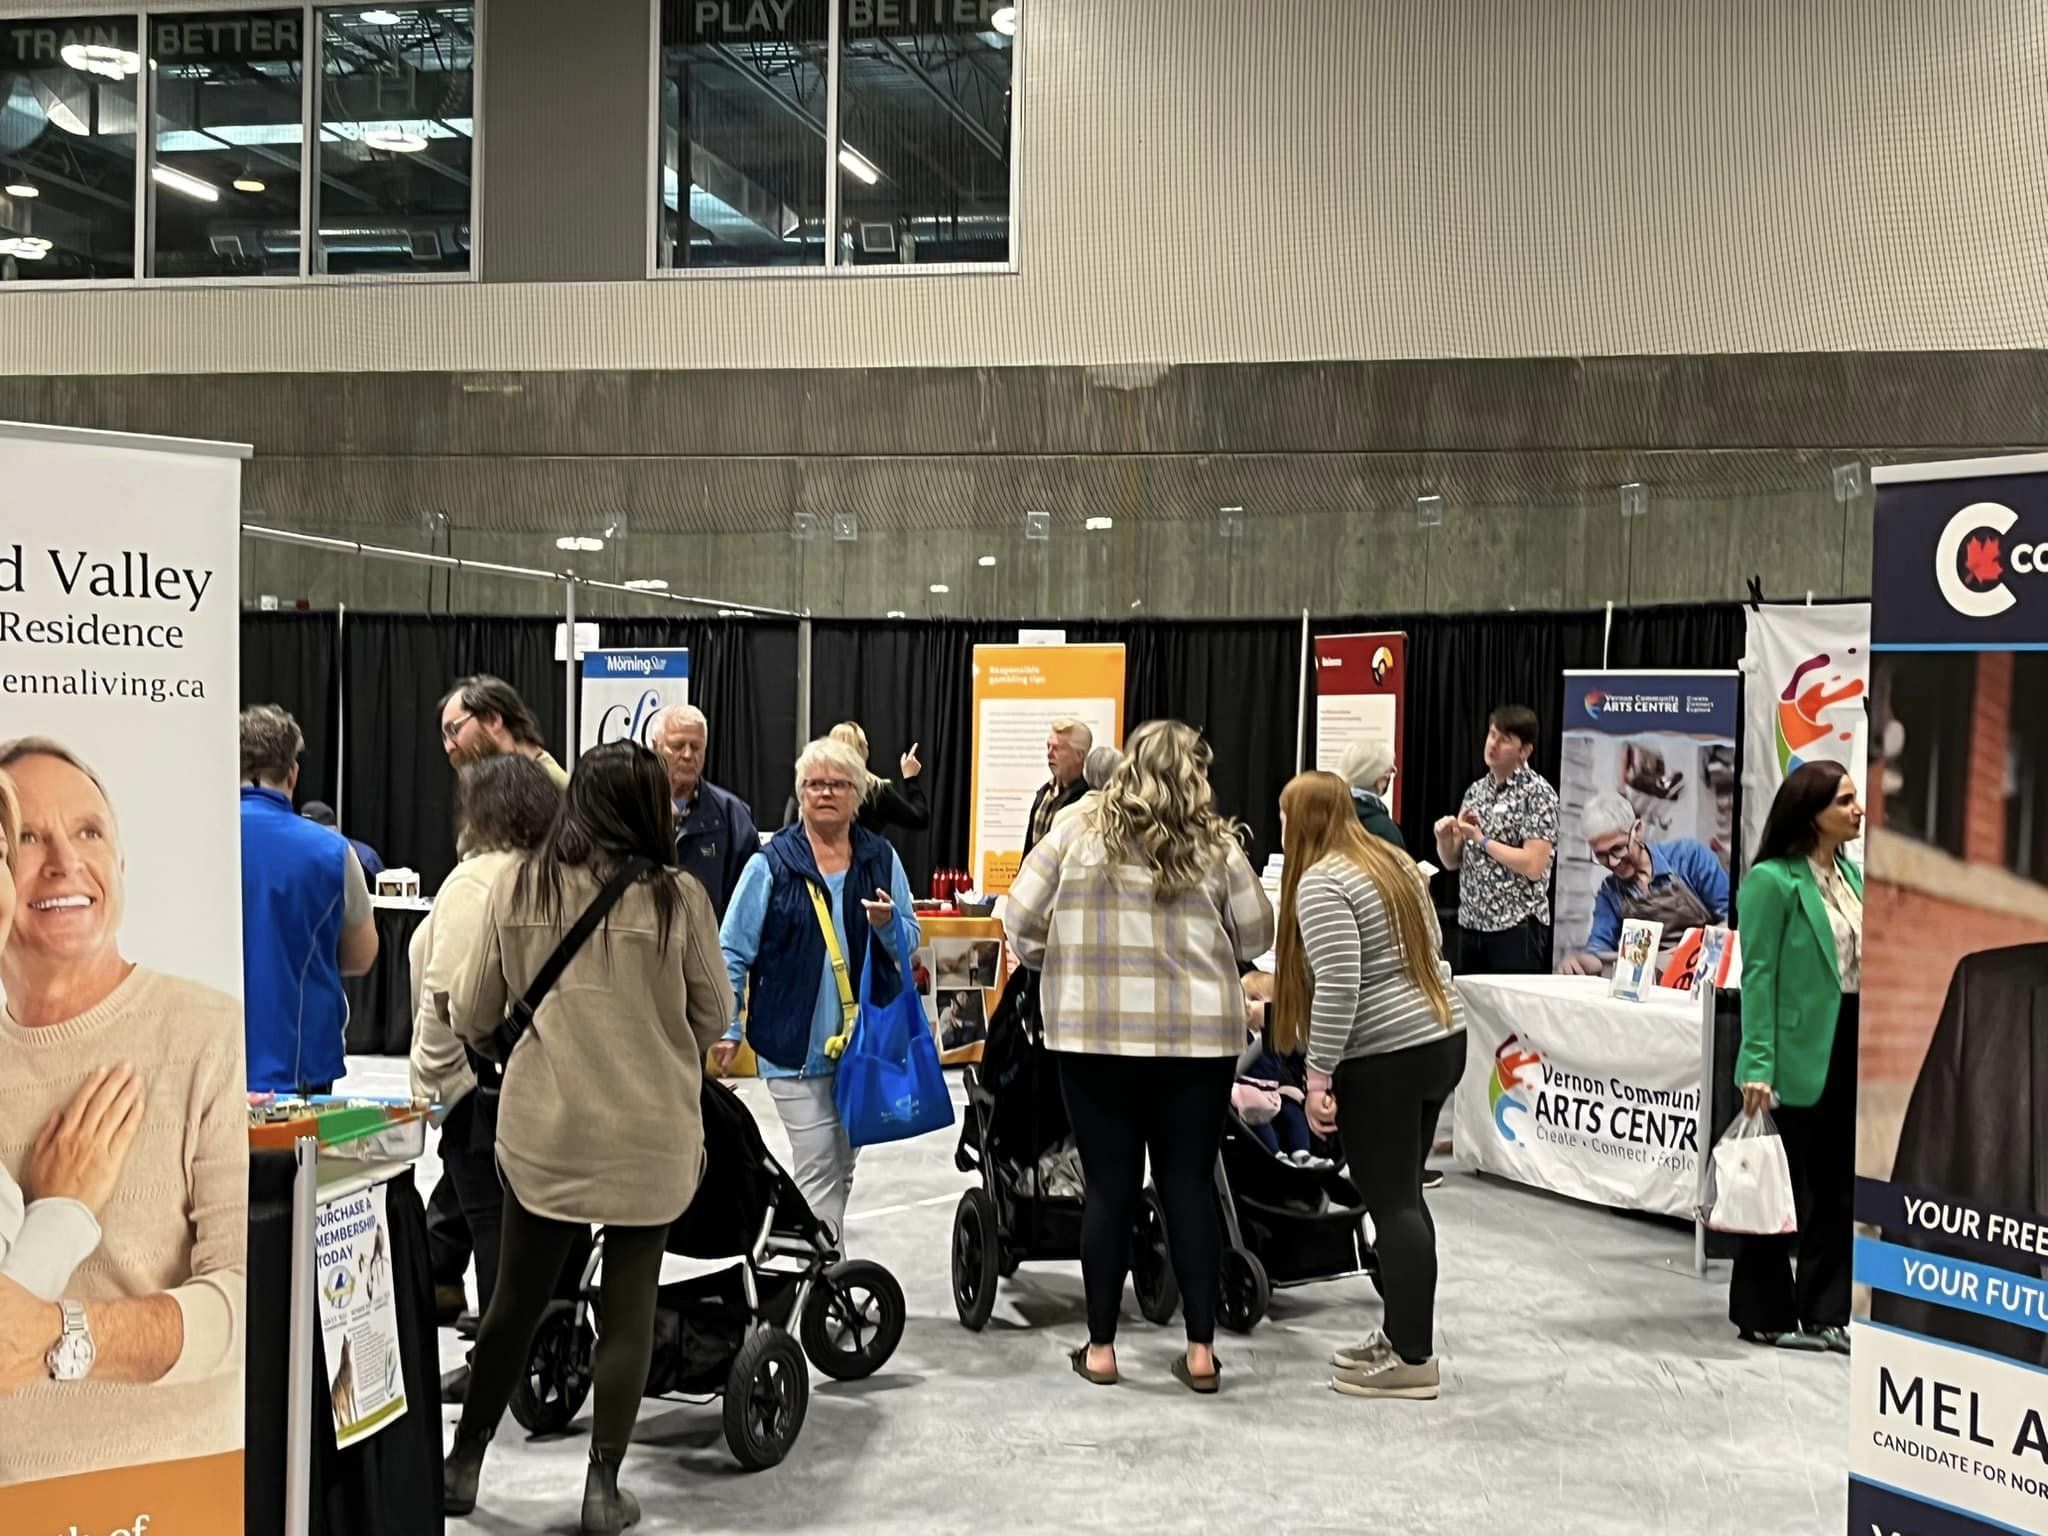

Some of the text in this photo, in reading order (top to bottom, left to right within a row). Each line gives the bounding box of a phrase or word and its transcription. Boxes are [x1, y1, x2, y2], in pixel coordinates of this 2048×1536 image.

[695, 0, 792, 34] PLAY
[157, 19, 299, 54] BETTER
[47, 549, 213, 612] Valley
[0, 611, 184, 649] Residence
[607, 655, 651, 675] Morning
[2, 669, 206, 703] ennaliving.ca
[1603, 702, 1679, 713] ARTS CENTRE
[1541, 1063, 1701, 1112] Vernon Communi
[1535, 1091, 1699, 1153] ARTS CENTR
[1536, 1124, 1577, 1148] Create
[1592, 1137, 1648, 1164] Connect
[316, 1197, 373, 1228] PURCHASE A
[1904, 1195, 2048, 1255] YOUR FREE
[316, 1215, 376, 1249] MEMBERSHIP
[317, 1243, 353, 1270] TODAY
[1903, 1257, 1979, 1302] YOUR
[1879, 1366, 2048, 1466] MEL A
[1872, 1431, 2048, 1499] CANDIDATE FOR NOR
